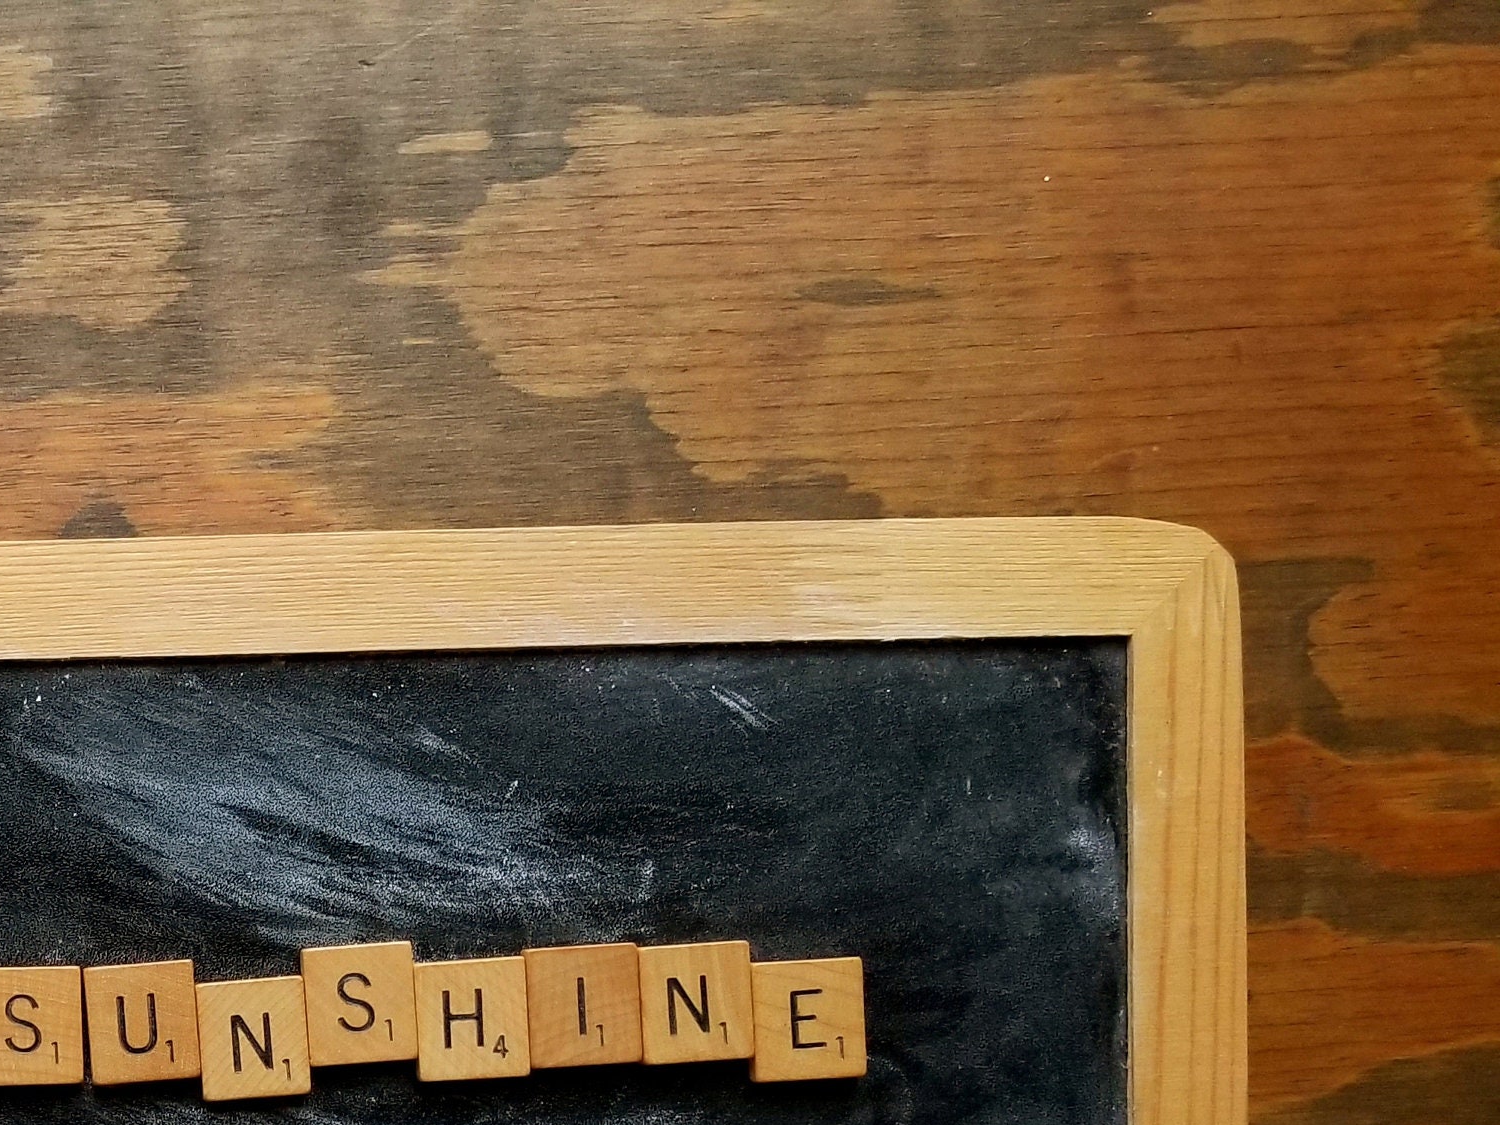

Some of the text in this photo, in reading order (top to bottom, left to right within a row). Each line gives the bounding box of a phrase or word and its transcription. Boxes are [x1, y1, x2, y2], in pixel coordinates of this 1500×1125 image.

[4, 972, 827, 1073] SUNSHINE
[384, 1018, 395, 1042] 1
[719, 1021, 729, 1045] 1
[492, 1034, 509, 1059] 4
[595, 1024, 605, 1047] 1
[49, 1041, 60, 1065] 1
[165, 1039, 176, 1063] 1
[835, 1036, 845, 1060] 1
[281, 1058, 292, 1081] 1
